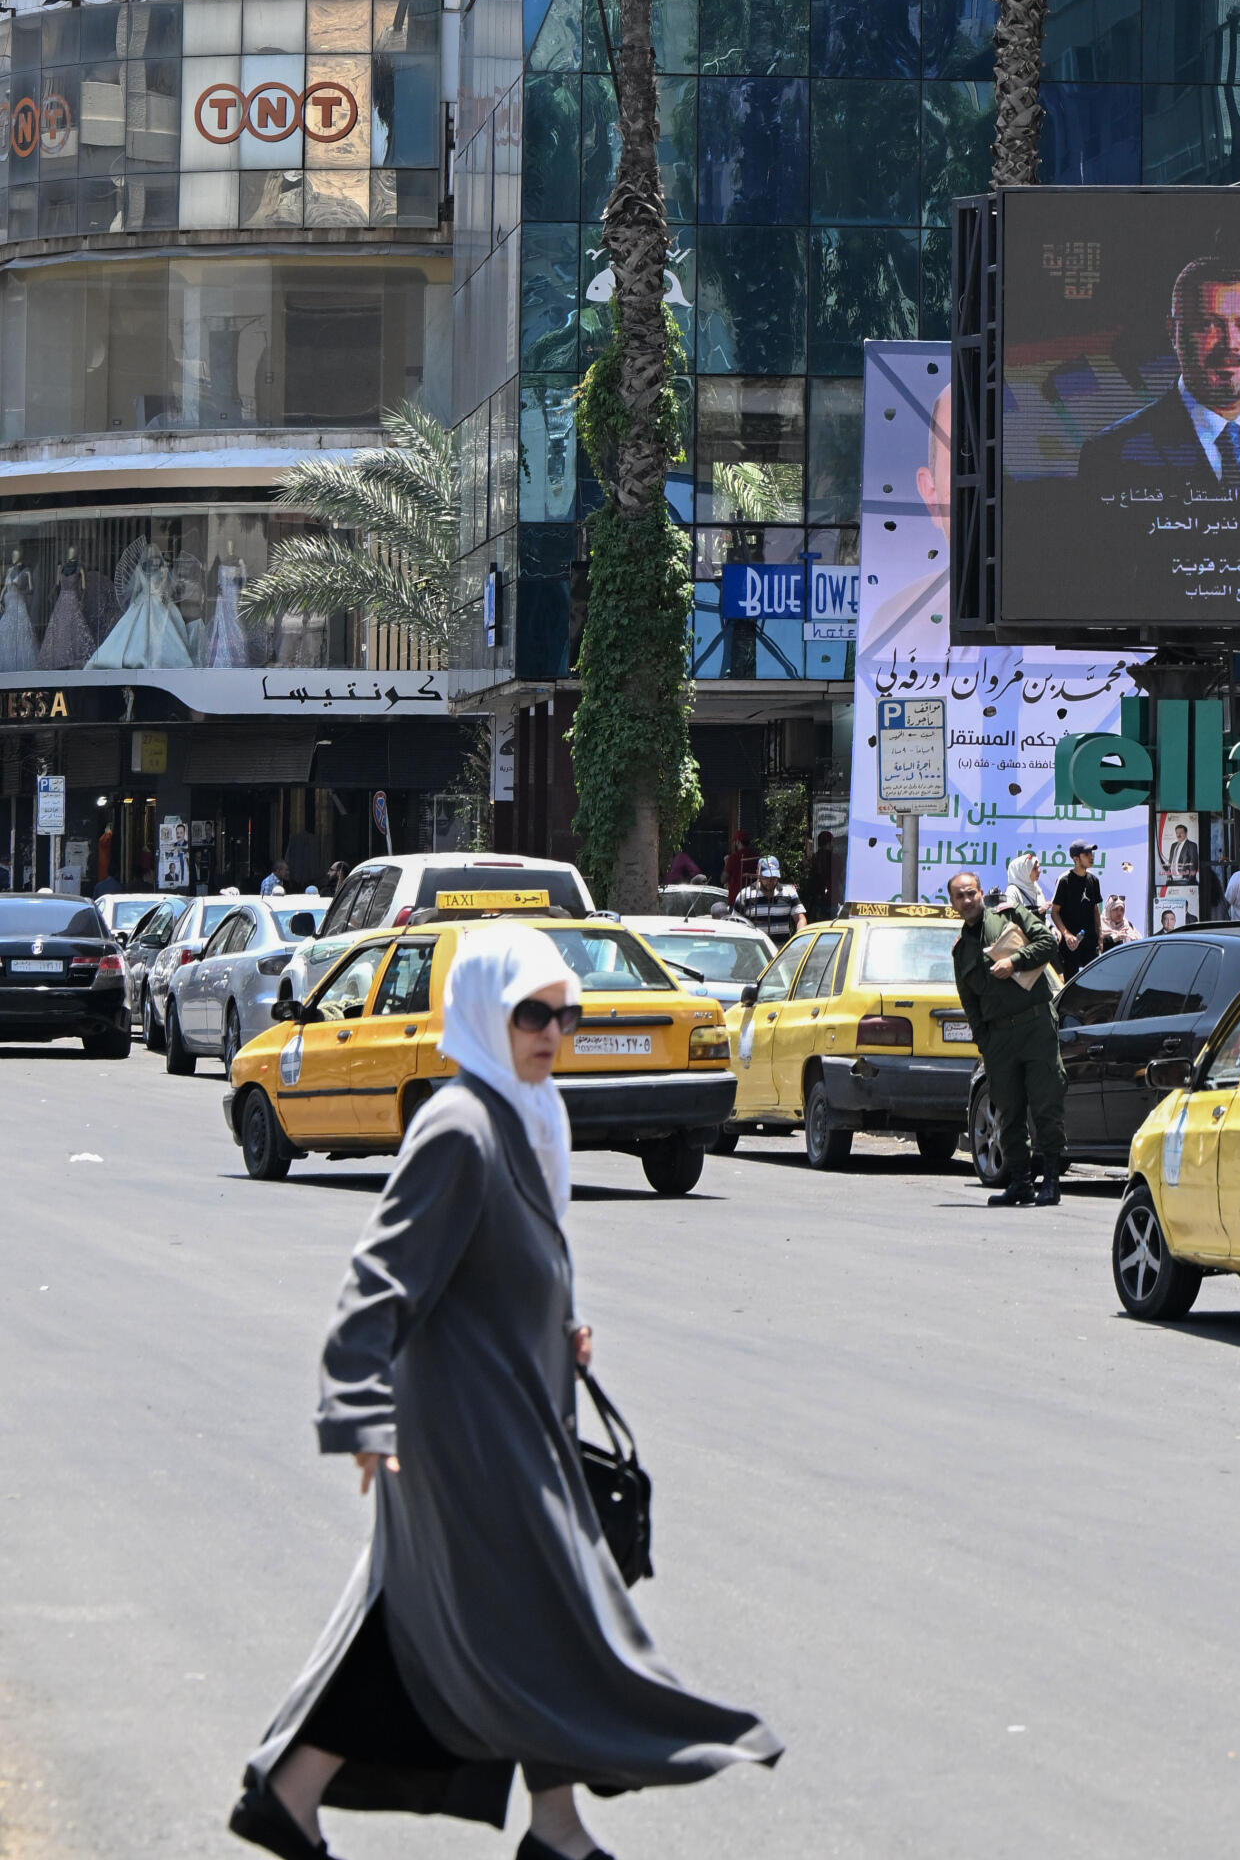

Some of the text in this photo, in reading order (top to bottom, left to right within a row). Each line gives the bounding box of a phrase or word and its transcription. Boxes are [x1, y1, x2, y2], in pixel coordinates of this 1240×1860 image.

[202, 89, 350, 136] TNT
[1148, 516, 1198, 534] الحفار
[1203, 516, 1238, 534] نذير
[738, 552, 860, 621] BLUE TOWE
[1185, 585, 1232, 600] الشباب
[812, 622, 857, 639] hote
[262, 675, 443, 711] كونتيسا
[8, 691, 68, 718] ESSA
[914, 702, 940, 714] مواقف
[883, 703, 902, 727] P
[906, 715, 934, 726] مأجورة
[947, 729, 1016, 750] المستقل
[974, 759, 990, 770] فئة
[996, 758, 1027, 771] دمشق
[40, 777, 48, 791] P
[444, 894, 474, 907] TAXI
[857, 904, 889, 917] TAXI
